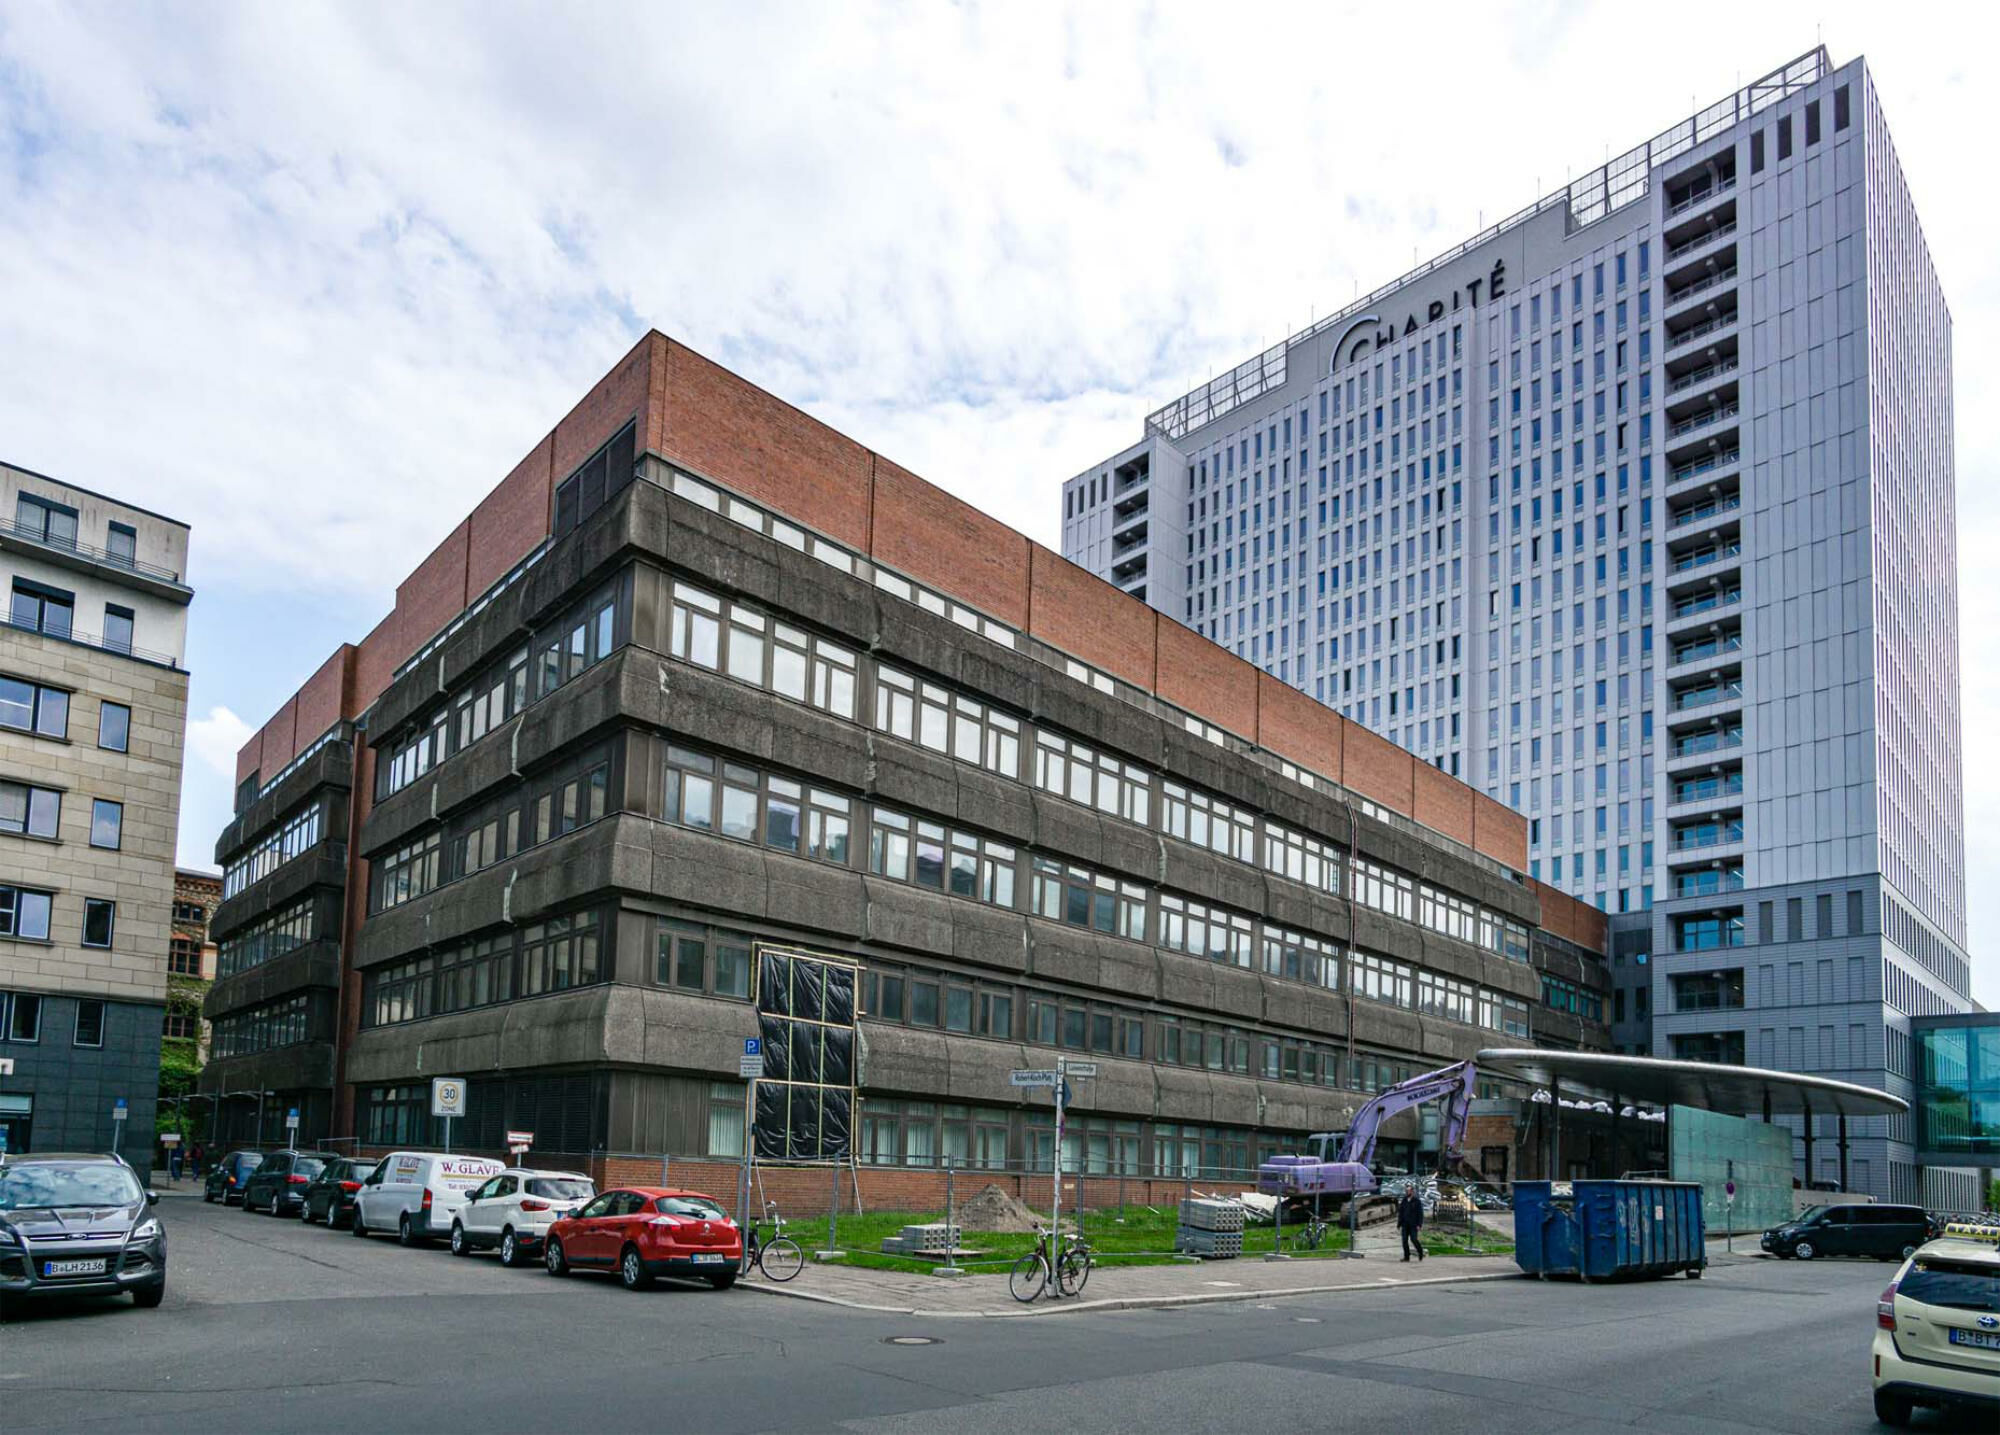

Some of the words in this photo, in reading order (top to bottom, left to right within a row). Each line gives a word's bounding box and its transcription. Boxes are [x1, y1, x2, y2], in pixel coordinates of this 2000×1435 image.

[1330, 258, 1505, 374] CHARITÉ
[747, 1040, 756, 1053] P
[444, 1088, 455, 1099] 30
[1954, 1226, 1992, 1236] TAXI
[80, 1261, 104, 1271] 2136
[1958, 1330, 1967, 1342] B
[1975, 1332, 1991, 1345] BT
